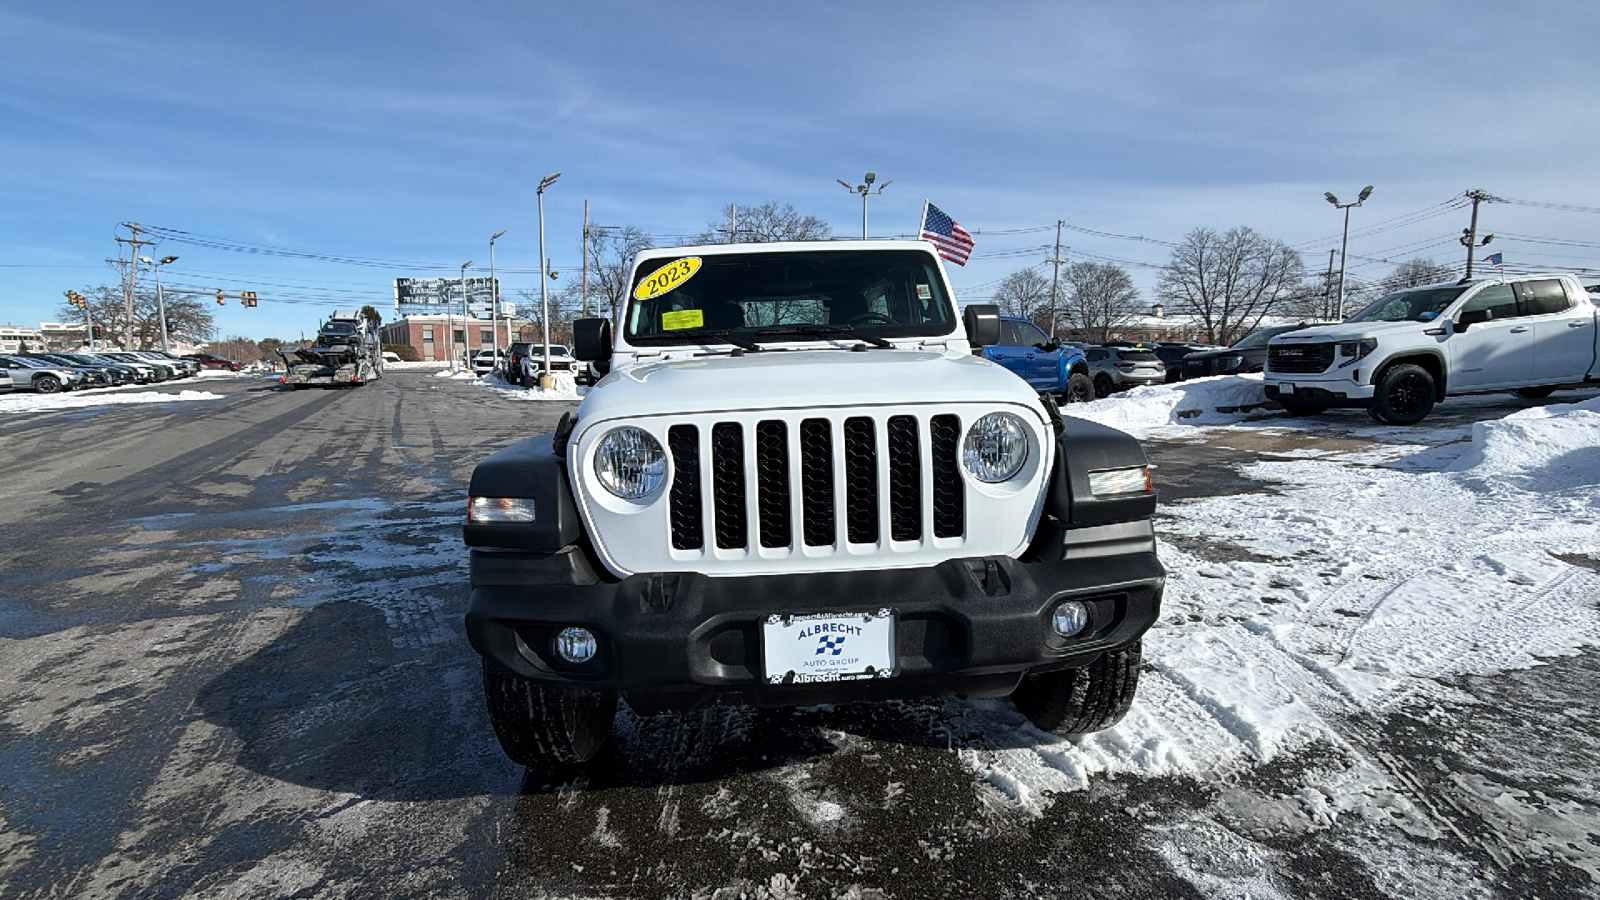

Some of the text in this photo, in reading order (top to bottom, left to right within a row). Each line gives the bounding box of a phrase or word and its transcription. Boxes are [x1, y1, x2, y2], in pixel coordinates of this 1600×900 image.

[647, 261, 691, 295] 2023
[798, 623, 862, 640] ALBRECHT
[803, 657, 859, 667] AUTO GROUP
[792, 672, 840, 684] Albrecht
